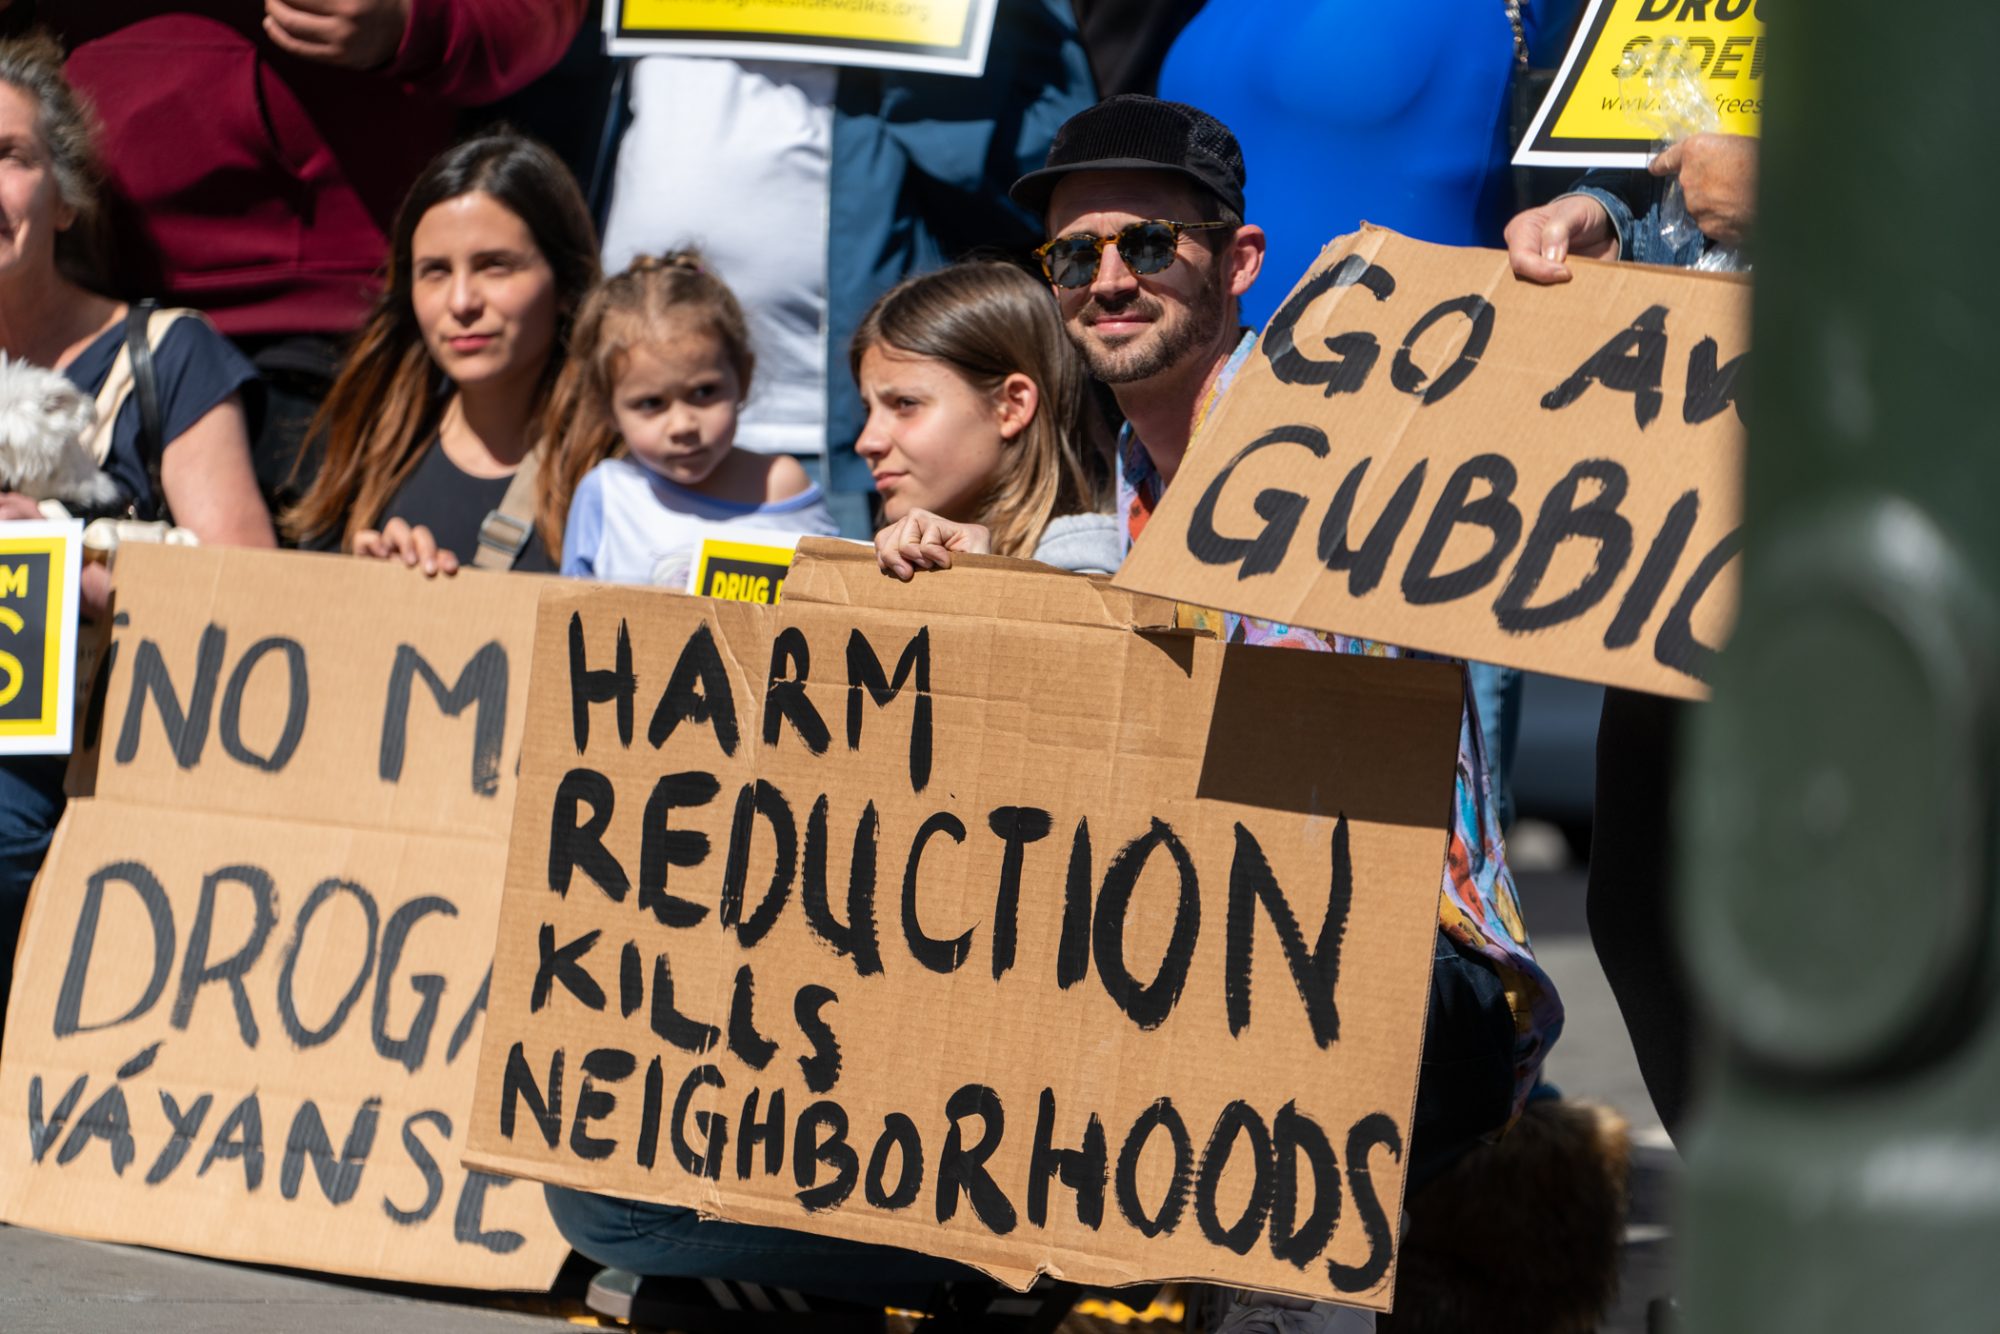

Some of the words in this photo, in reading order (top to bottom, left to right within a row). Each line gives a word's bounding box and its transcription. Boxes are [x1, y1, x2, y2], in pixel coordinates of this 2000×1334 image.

[1262, 253, 1496, 406] GO
[710, 570, 770, 604] DRUG
[379, 640, 520, 798] M
[568, 610, 933, 793] HARM
[548, 767, 1353, 1050] REDUCTION
[530, 921, 843, 1094] KILLS
[29, 1041, 527, 1254] VÁYANSE
[500, 1041, 1402, 1294] NEIGHBORHOODS
